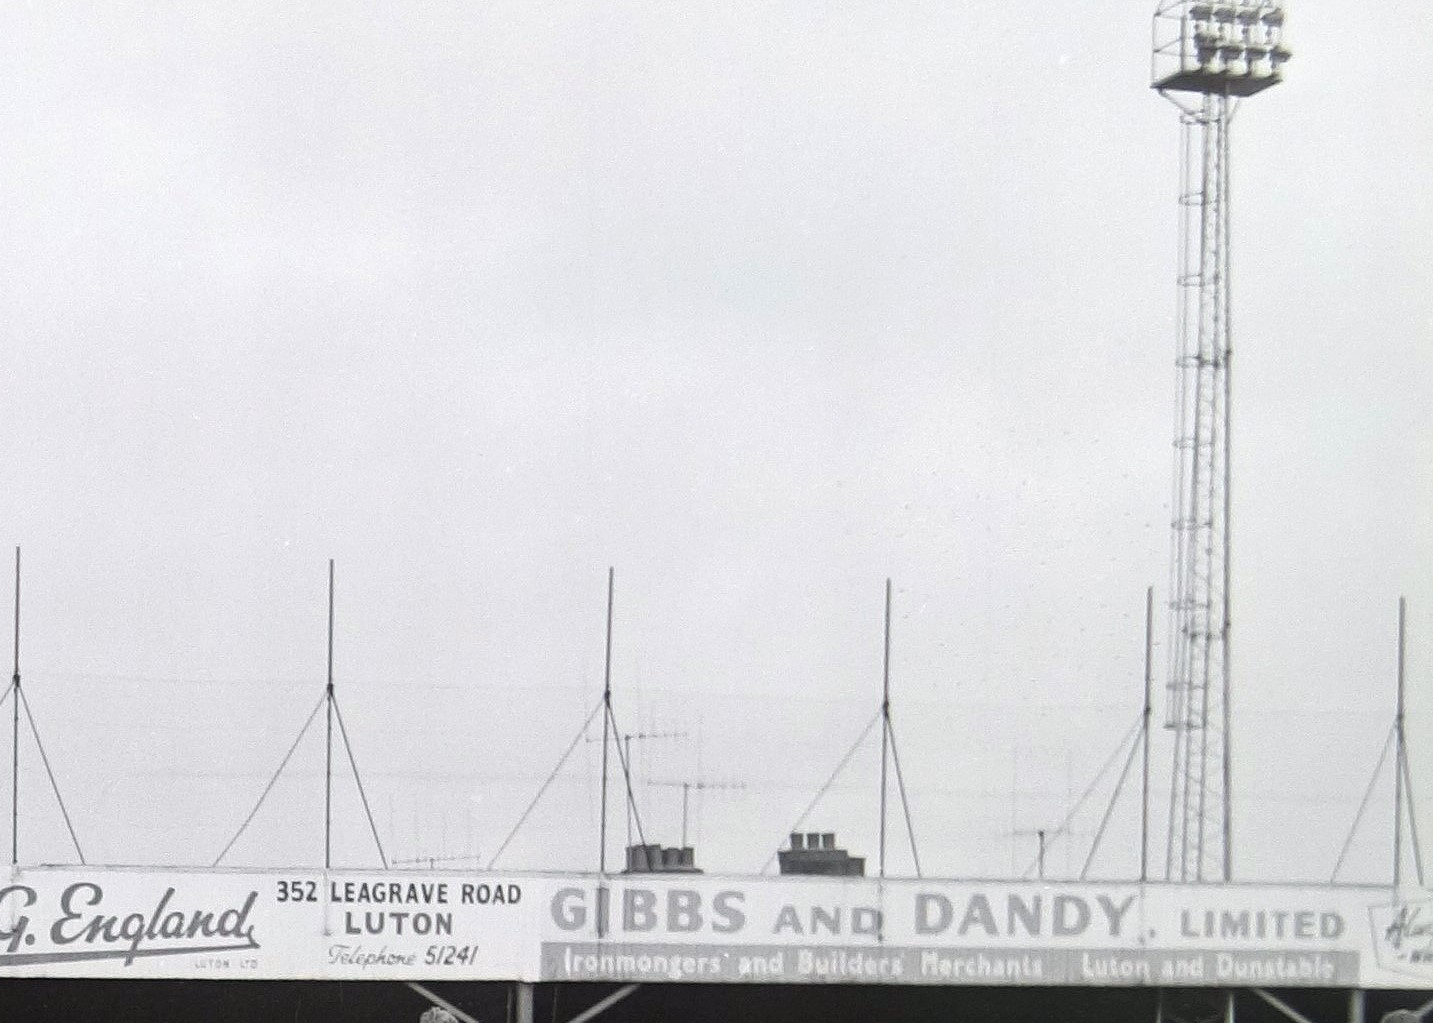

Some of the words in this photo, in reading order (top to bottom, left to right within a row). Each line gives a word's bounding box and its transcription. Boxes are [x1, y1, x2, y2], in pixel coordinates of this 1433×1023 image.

[276, 881, 318, 902] 352
[330, 883, 449, 905] LEAGRAVE
[461, 884, 522, 905] ROAD
[50, 882, 260, 967] England
[345, 911, 453, 935] LUTON
[550, 887, 747, 933] GIBBS
[772, 905, 883, 937] AND
[1180, 910, 1345, 940] LIMITED
[328, 945, 416, 970] Telephone
[424, 944, 478, 966] 51241
